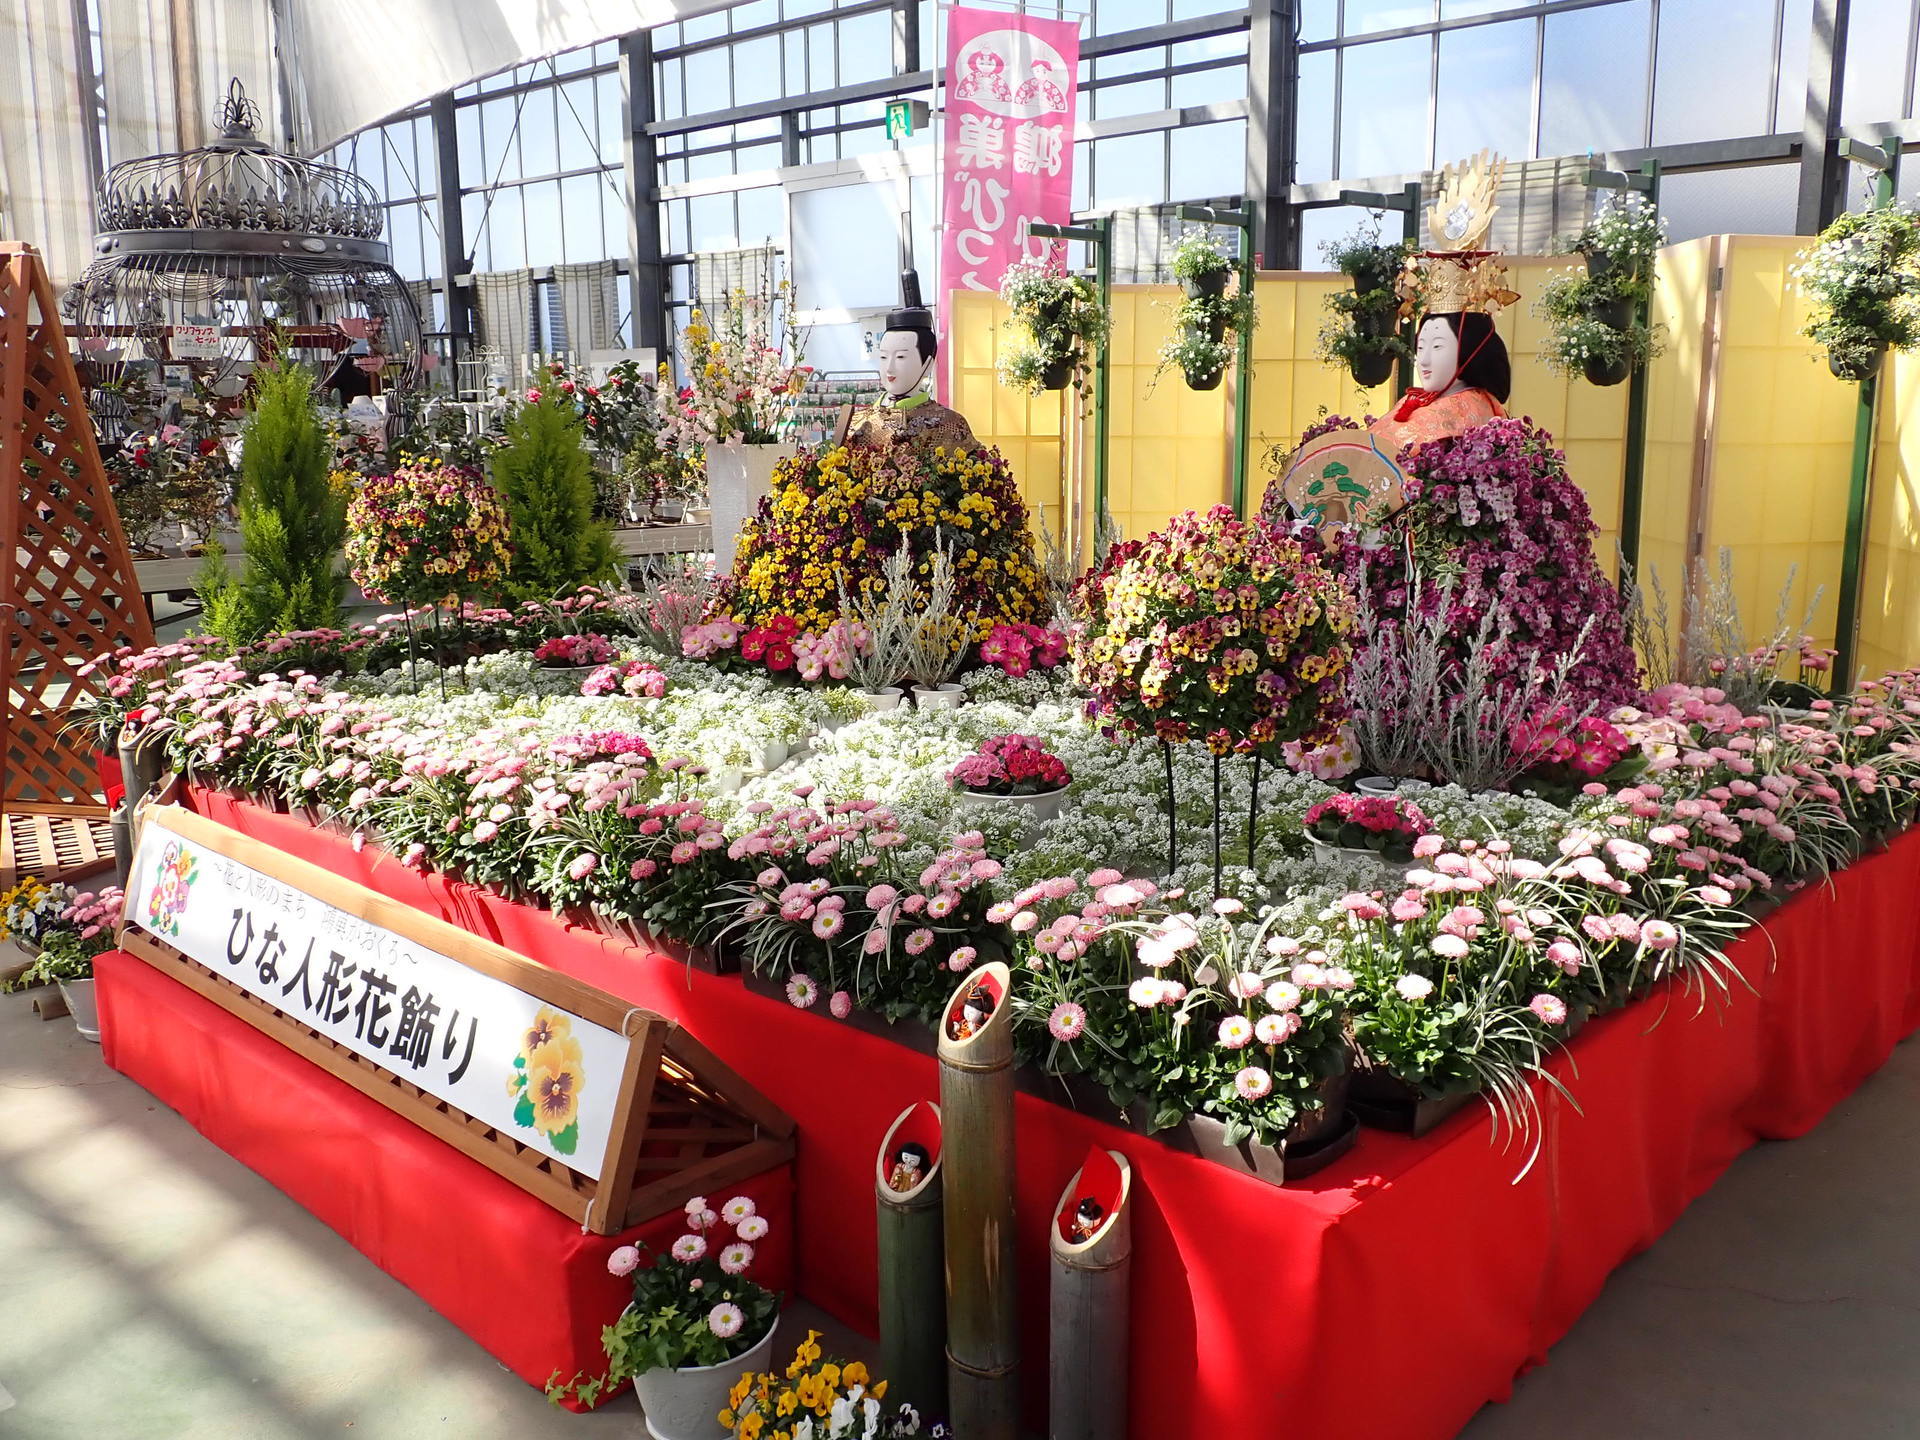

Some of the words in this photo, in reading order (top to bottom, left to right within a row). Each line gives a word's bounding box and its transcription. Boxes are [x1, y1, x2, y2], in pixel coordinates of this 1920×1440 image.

[226, 908, 478, 1086] ひな人形花飾り
